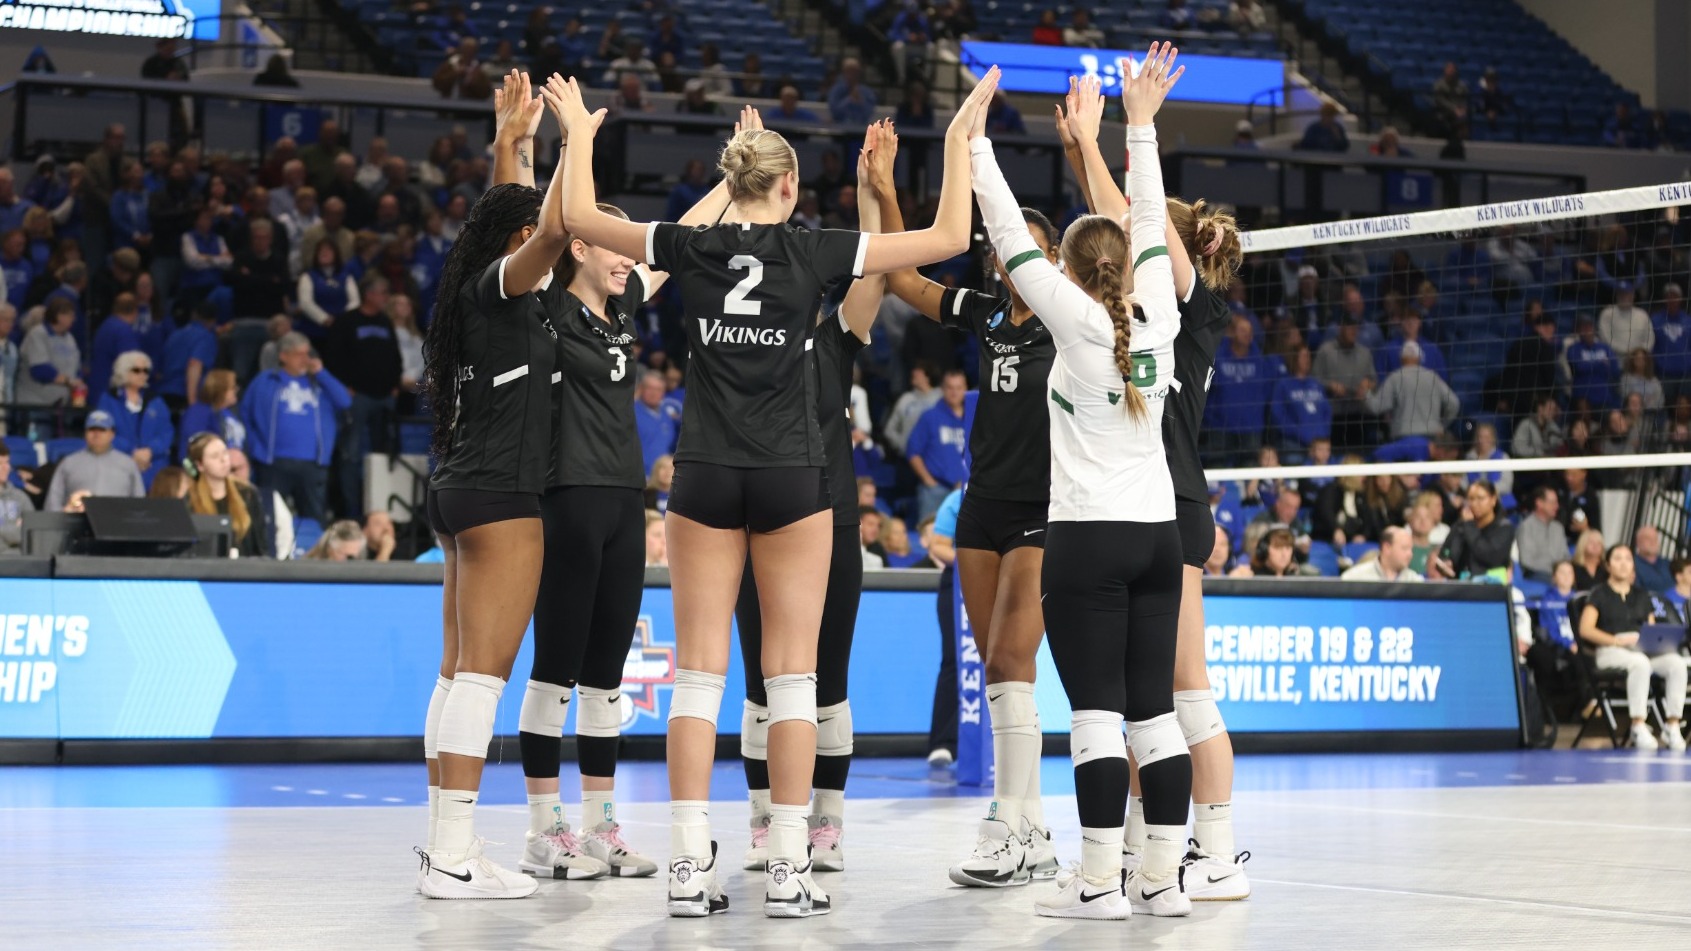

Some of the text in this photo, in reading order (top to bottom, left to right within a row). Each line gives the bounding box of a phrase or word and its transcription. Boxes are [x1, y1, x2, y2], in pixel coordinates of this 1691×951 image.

[282, 113, 303, 137] 6
[1313, 215, 1411, 240] KENTUCKY WILDCATS
[1477, 196, 1585, 222] KENTUCKY WILDCATS
[723, 254, 764, 316] 2
[607, 346, 627, 382] 3
[991, 355, 1021, 393] 15
[0, 614, 90, 657] EN'S
[1204, 625, 1414, 663] CEMBER 19 & 22
[1206, 665, 1441, 705] SVILLE, KENTUCKY
